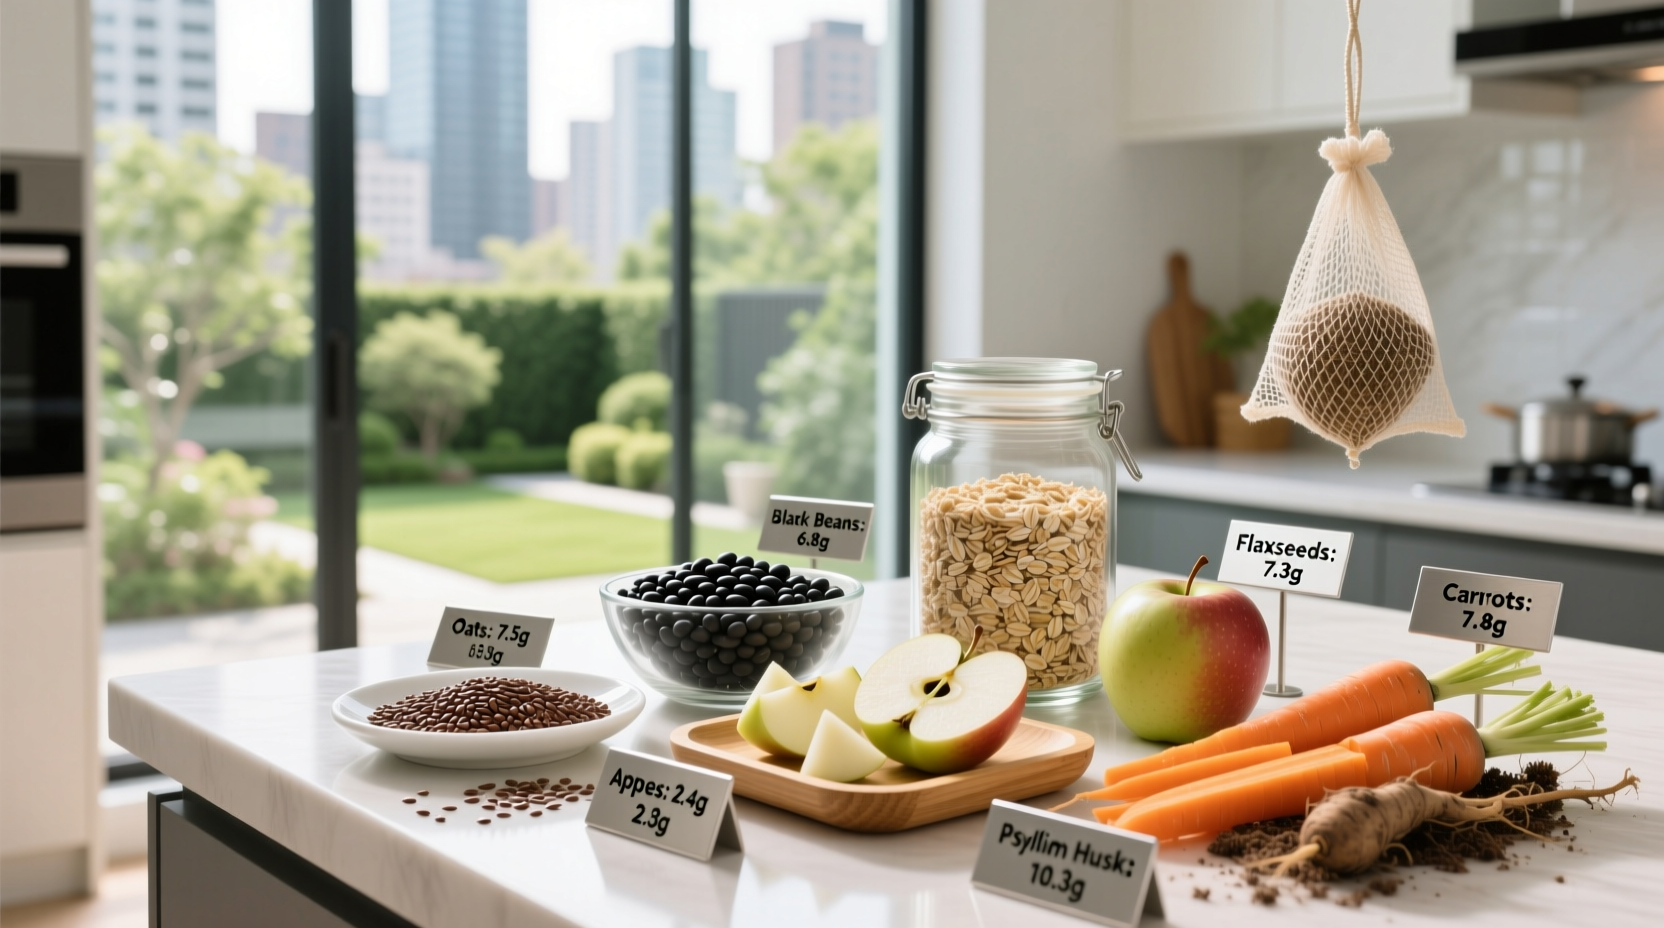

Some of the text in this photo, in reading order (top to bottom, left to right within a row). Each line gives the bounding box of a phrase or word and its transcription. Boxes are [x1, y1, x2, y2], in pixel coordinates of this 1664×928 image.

[813, 512, 866, 532] Beans:
[797, 531, 830, 552] 6.8g
[1236, 533, 1337, 562] Flaxseeds:
[1263, 560, 1304, 586] 7.3g
[452, 617, 531, 648] Oats: 7.5g
[1462, 610, 1507, 638] 7.8g
[609, 767, 709, 817] Appes: 2.4g
[998, 822, 1136, 878] Psyllim Husk:
[1030, 862, 1086, 903] 10.3g
